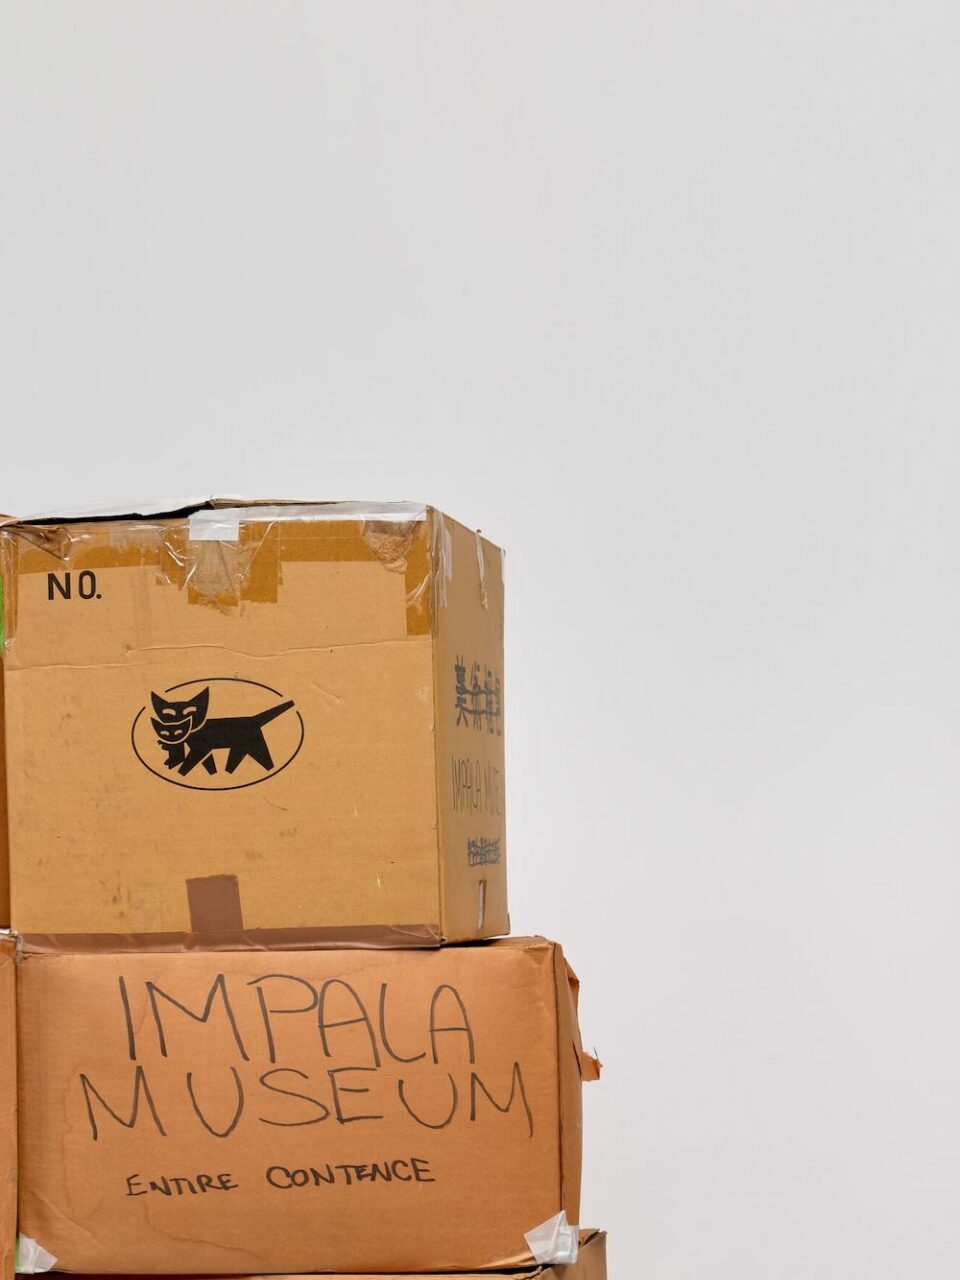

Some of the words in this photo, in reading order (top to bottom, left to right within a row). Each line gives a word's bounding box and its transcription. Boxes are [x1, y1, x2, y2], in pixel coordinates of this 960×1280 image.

[48, 569, 102, 601] NO.
[119, 973, 475, 1067] IMPALA
[80, 1062, 534, 1141] MUSEUM
[126, 1173, 239, 1197] ENTIRE
[265, 1157, 436, 1190] CONTENCE
